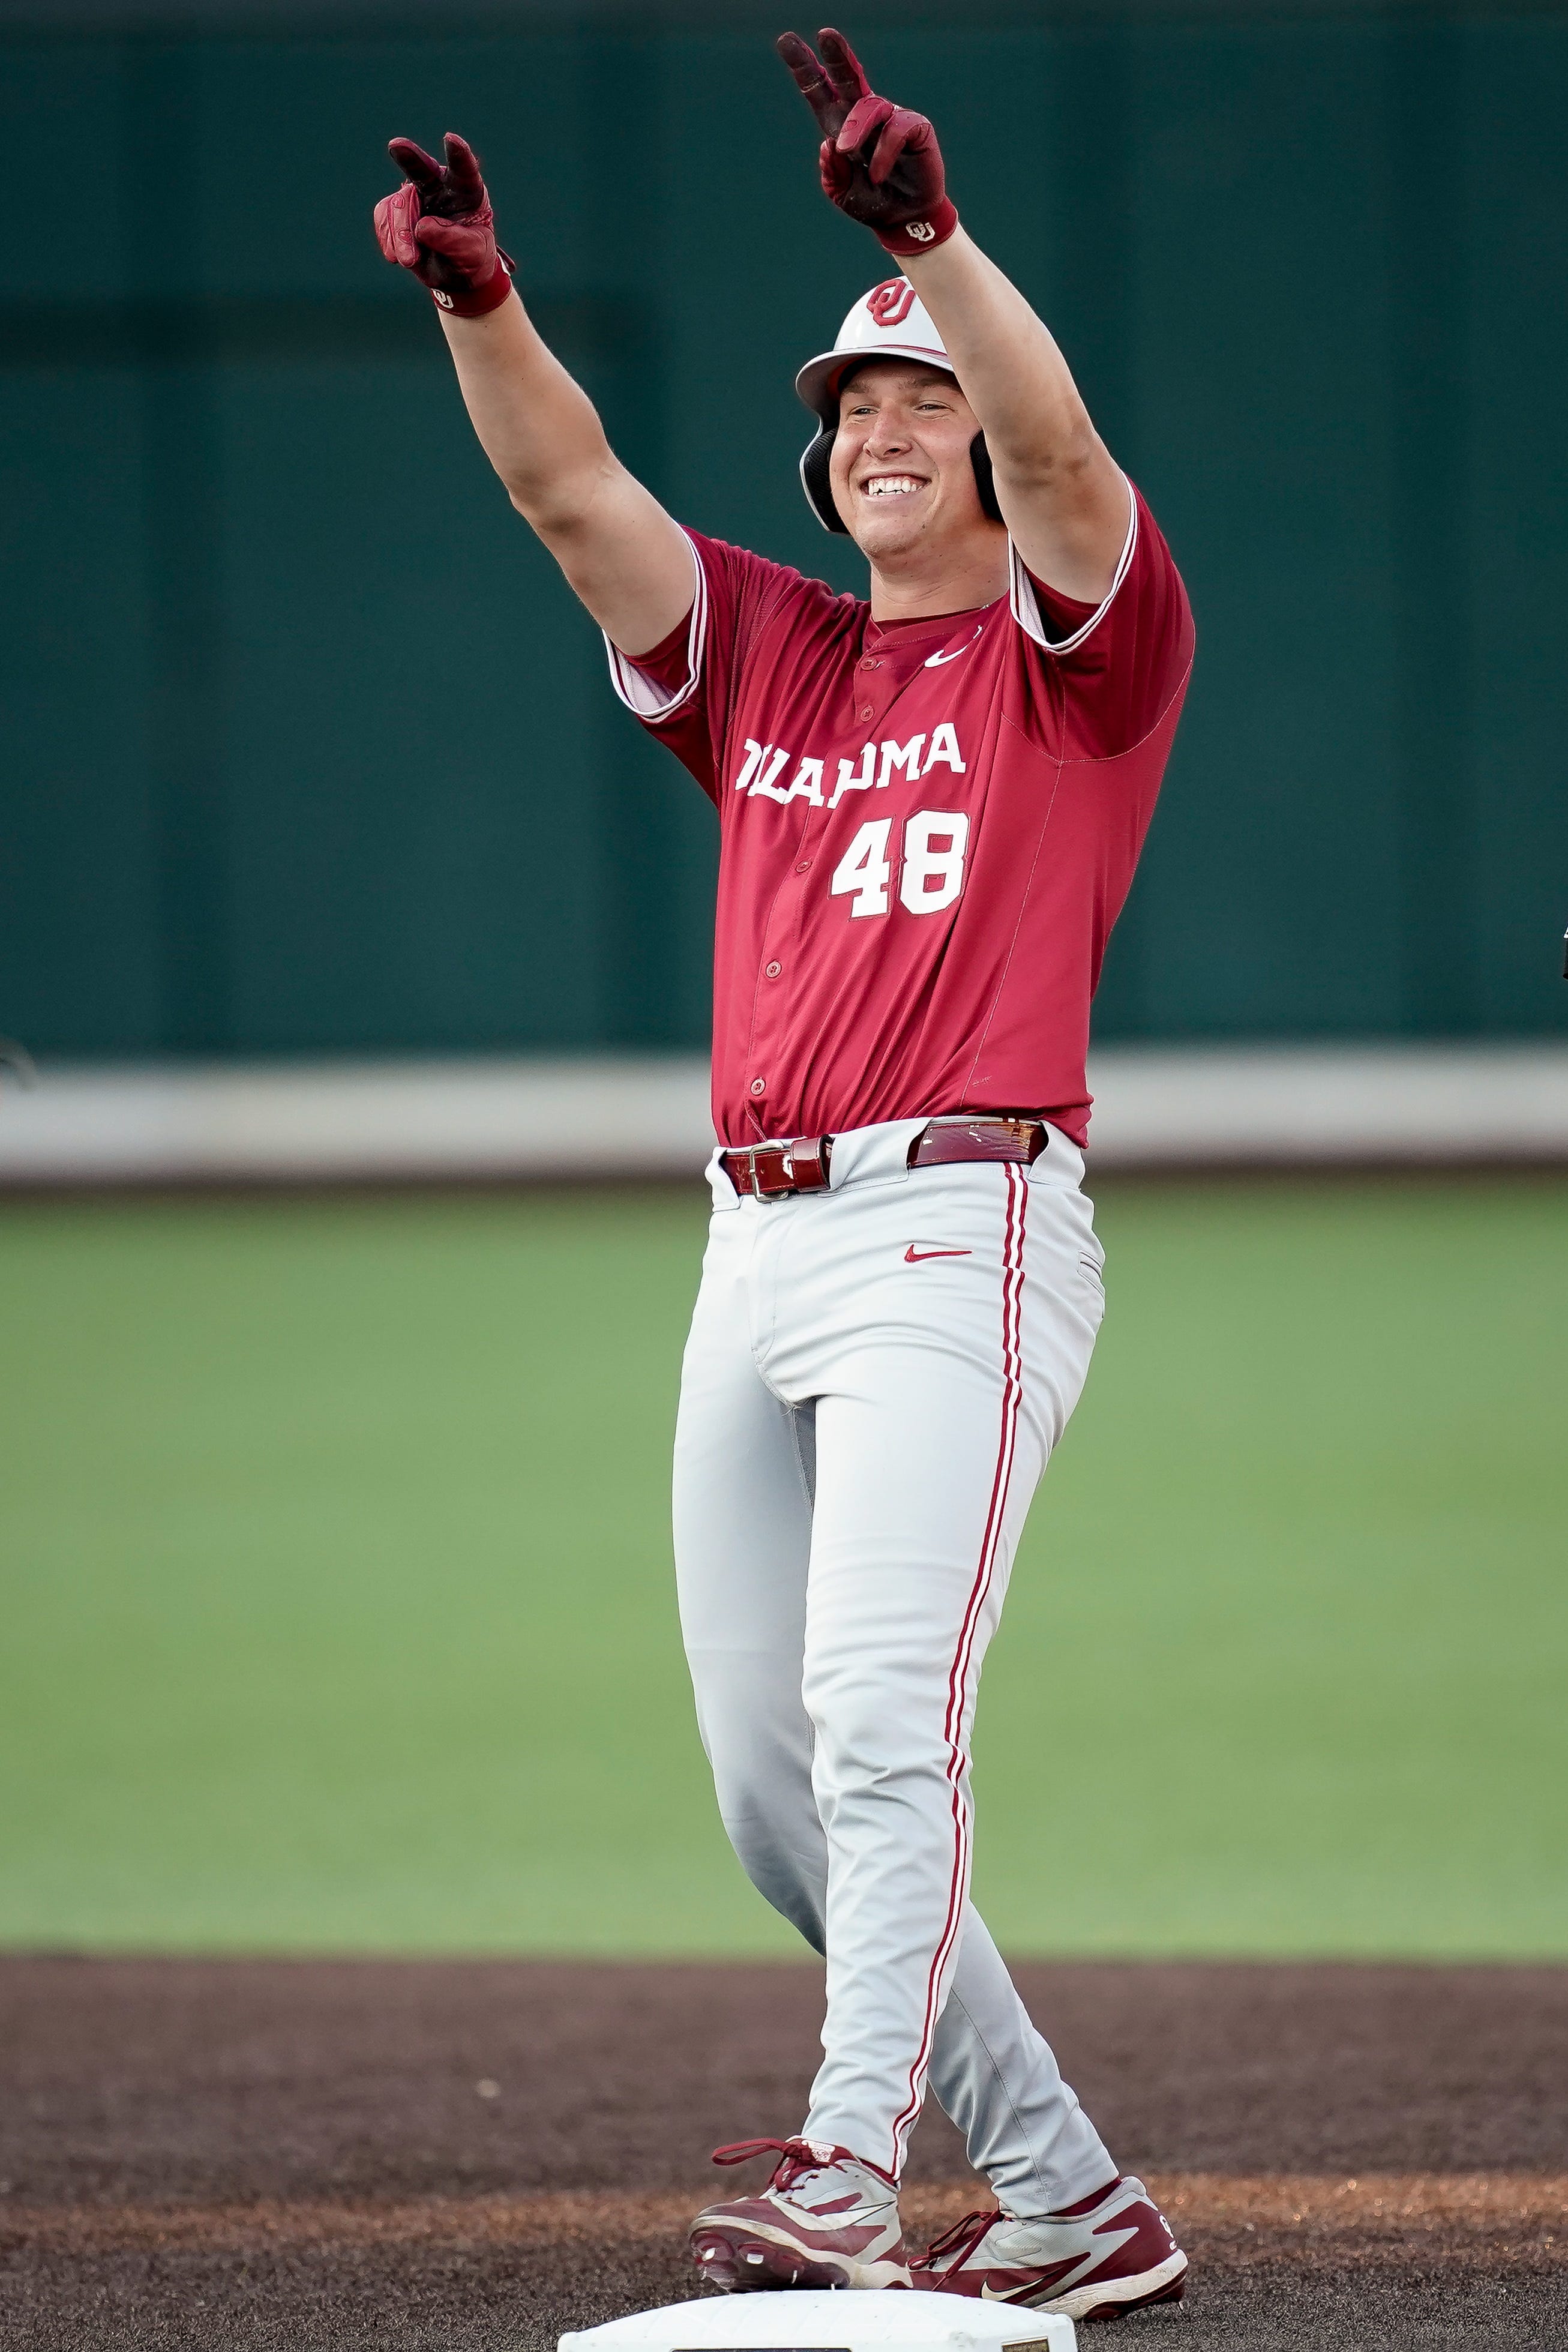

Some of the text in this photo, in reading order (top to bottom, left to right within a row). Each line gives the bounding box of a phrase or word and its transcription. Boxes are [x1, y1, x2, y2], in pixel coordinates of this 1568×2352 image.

[906, 221, 936, 242] OU
[866, 278, 916, 327] OU
[829, 808, 970, 919] 48
